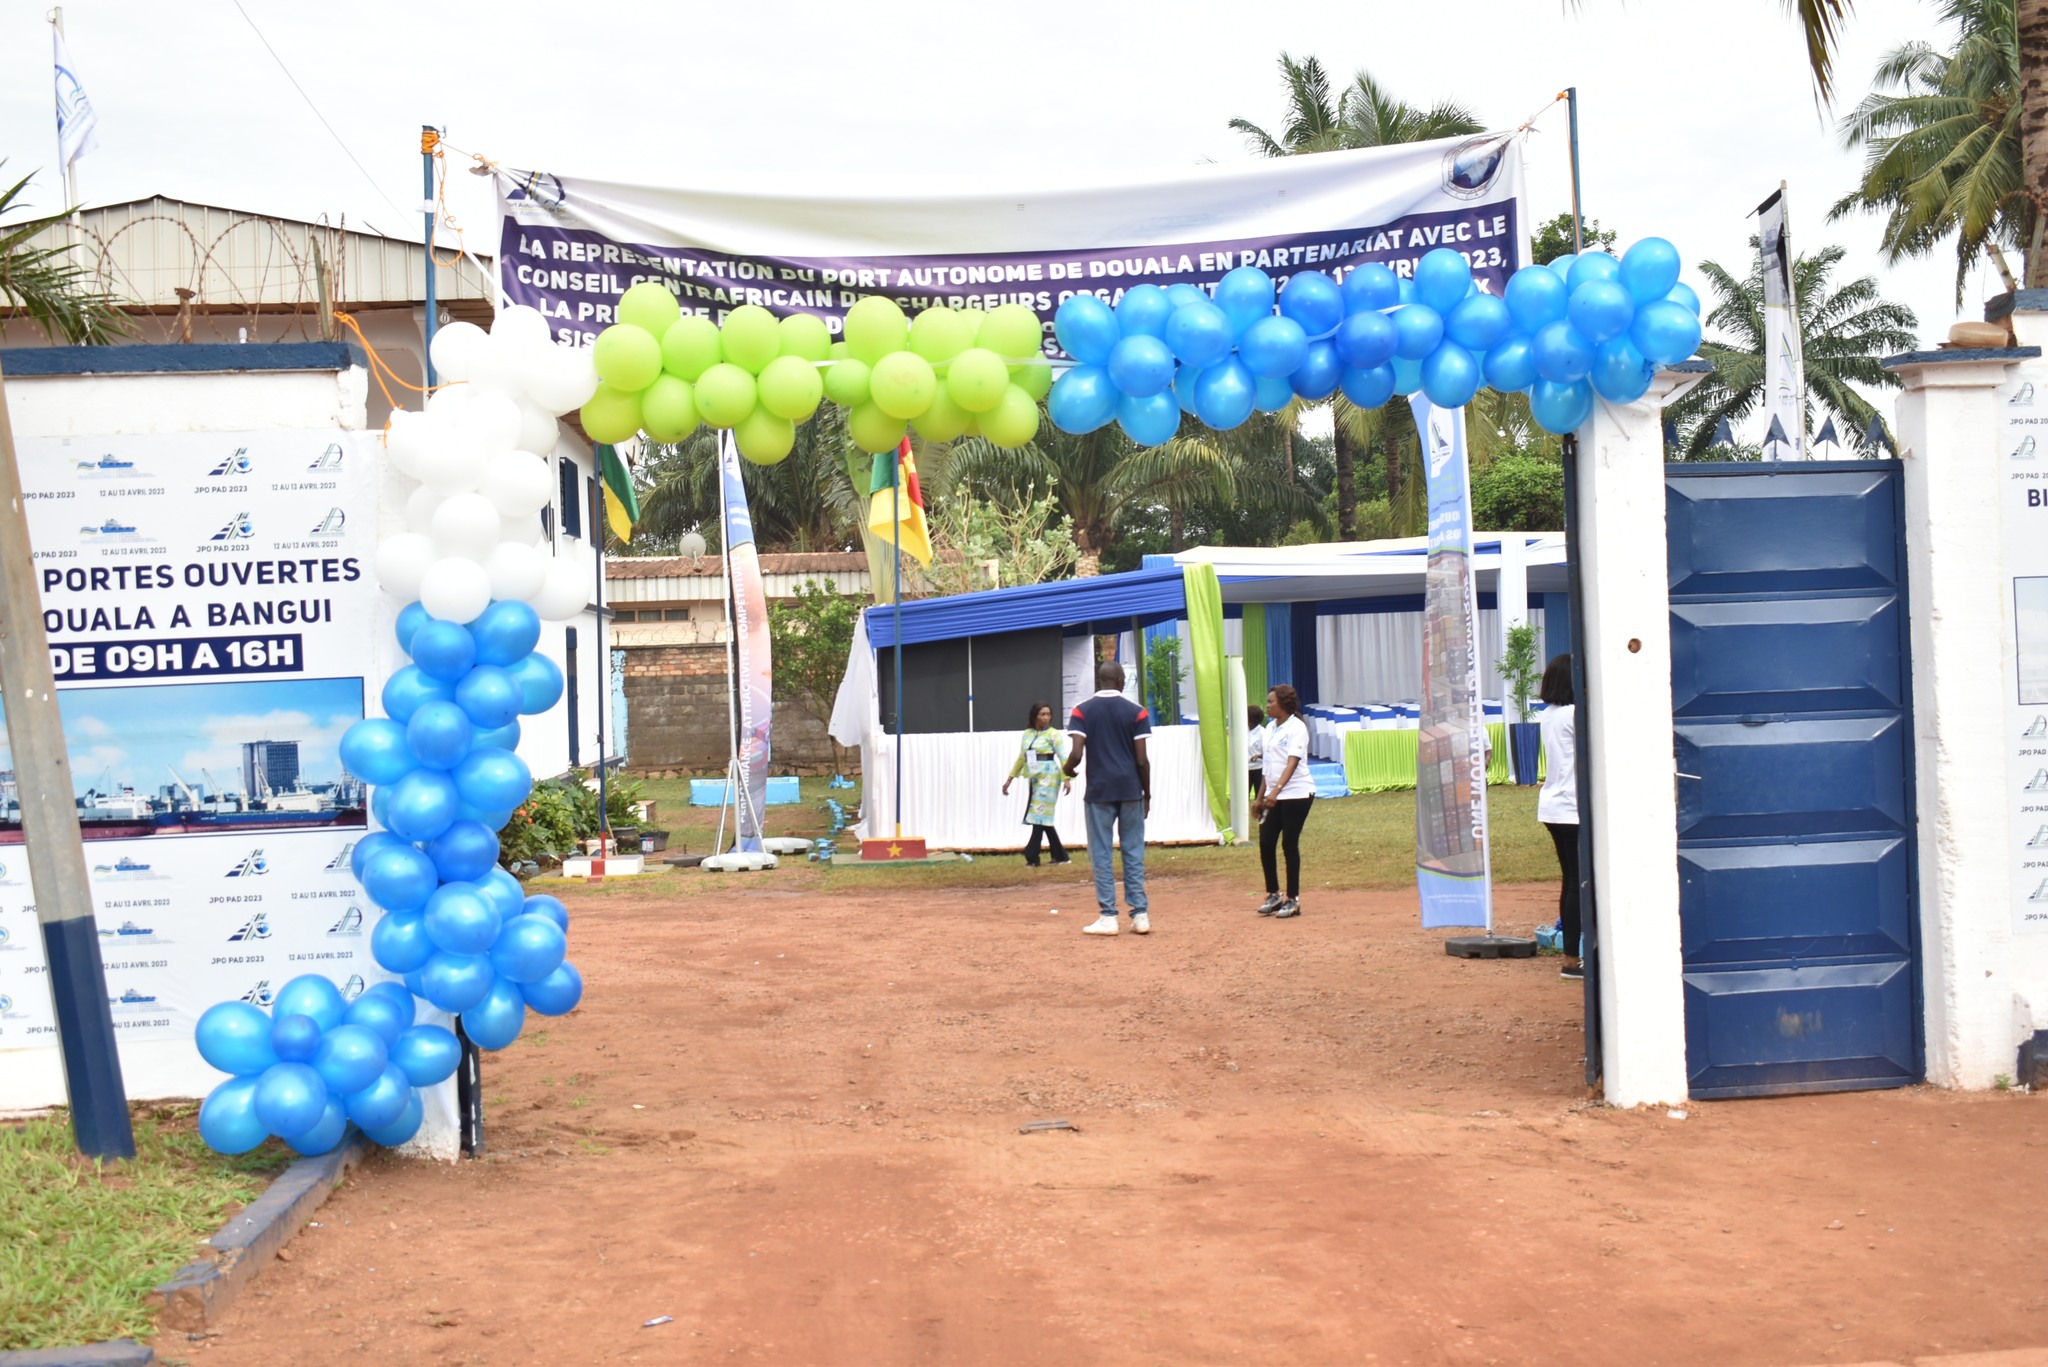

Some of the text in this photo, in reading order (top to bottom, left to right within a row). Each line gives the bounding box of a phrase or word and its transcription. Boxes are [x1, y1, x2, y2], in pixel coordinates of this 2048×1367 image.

[519, 214, 1507, 288] LA REPRESENTATION DU PORT AUTONOME DE DOUALA EN PARTENARIAT AVEC LE
[517, 264, 625, 295] CONSEIL
[540, 297, 572, 320] LA
[2009, 418, 2024, 426] JPO
[2024, 417, 2039, 425] PAD
[194, 486, 210, 494] JPO
[211, 485, 228, 493] PAD
[279, 483, 290, 491] AU
[298, 482, 319, 490] AVRIL
[38, 491, 55, 499] PAD
[107, 489, 118, 497] AU
[127, 488, 147, 496] AVRIL
[196, 545, 212, 553] JPO
[213, 544, 230, 552] PAD
[281, 542, 292, 550] AU
[300, 541, 321, 549] AVRIL
[40, 550, 57, 559] PAD
[109, 548, 120, 556] AU
[128, 547, 149, 555] AVRIL
[43, 557, 362, 593] PORTES OUVERTES
[43, 598, 332, 634] OUALA A BANGUI
[51, 638, 295, 675] DE 09H A 16H
[208, 896, 225, 904] JPO
[226, 895, 242, 903] PAD
[299, 892, 310, 900] AU
[318, 890, 338, 899] AVRIL
[112, 900, 124, 908] AU
[132, 899, 152, 907] AVRIL
[211, 957, 227, 965] JPO
[228, 956, 244, 964] PAD
[296, 953, 307, 961] AU
[315, 952, 336, 960] AVRIL
